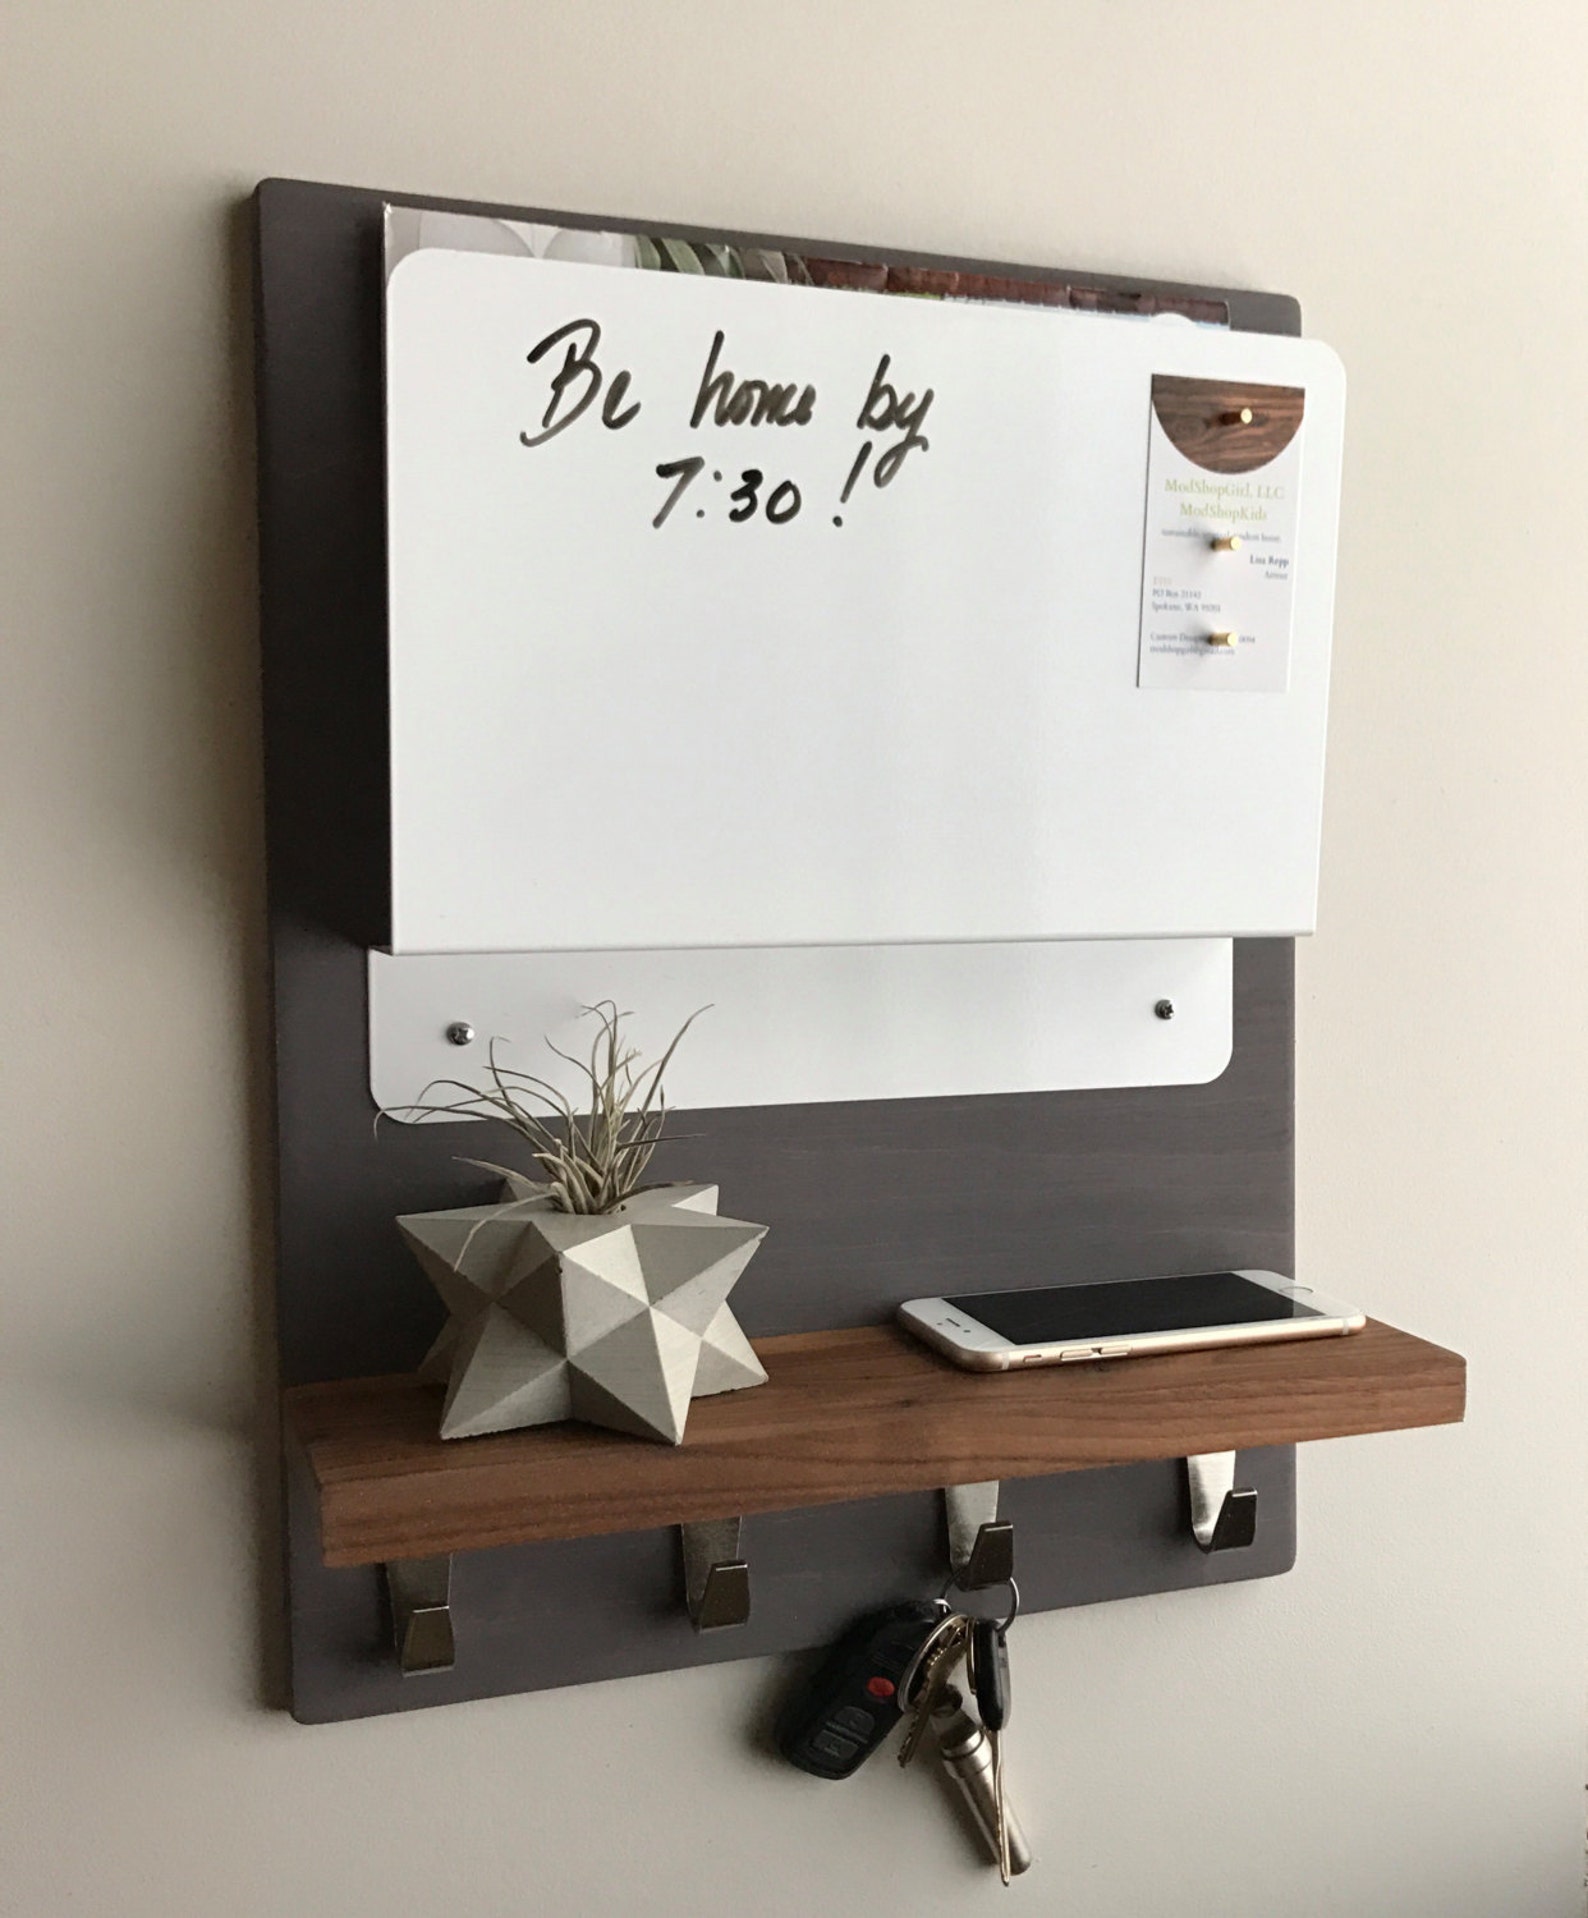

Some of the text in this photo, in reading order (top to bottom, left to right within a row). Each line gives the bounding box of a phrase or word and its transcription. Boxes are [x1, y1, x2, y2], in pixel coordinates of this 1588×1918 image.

[520, 318, 935, 488] Be home by
[652, 456, 802, 529] 7:30
[1180, 503, 1268, 523] ModShopKids
[1256, 485, 1285, 500] LLC
